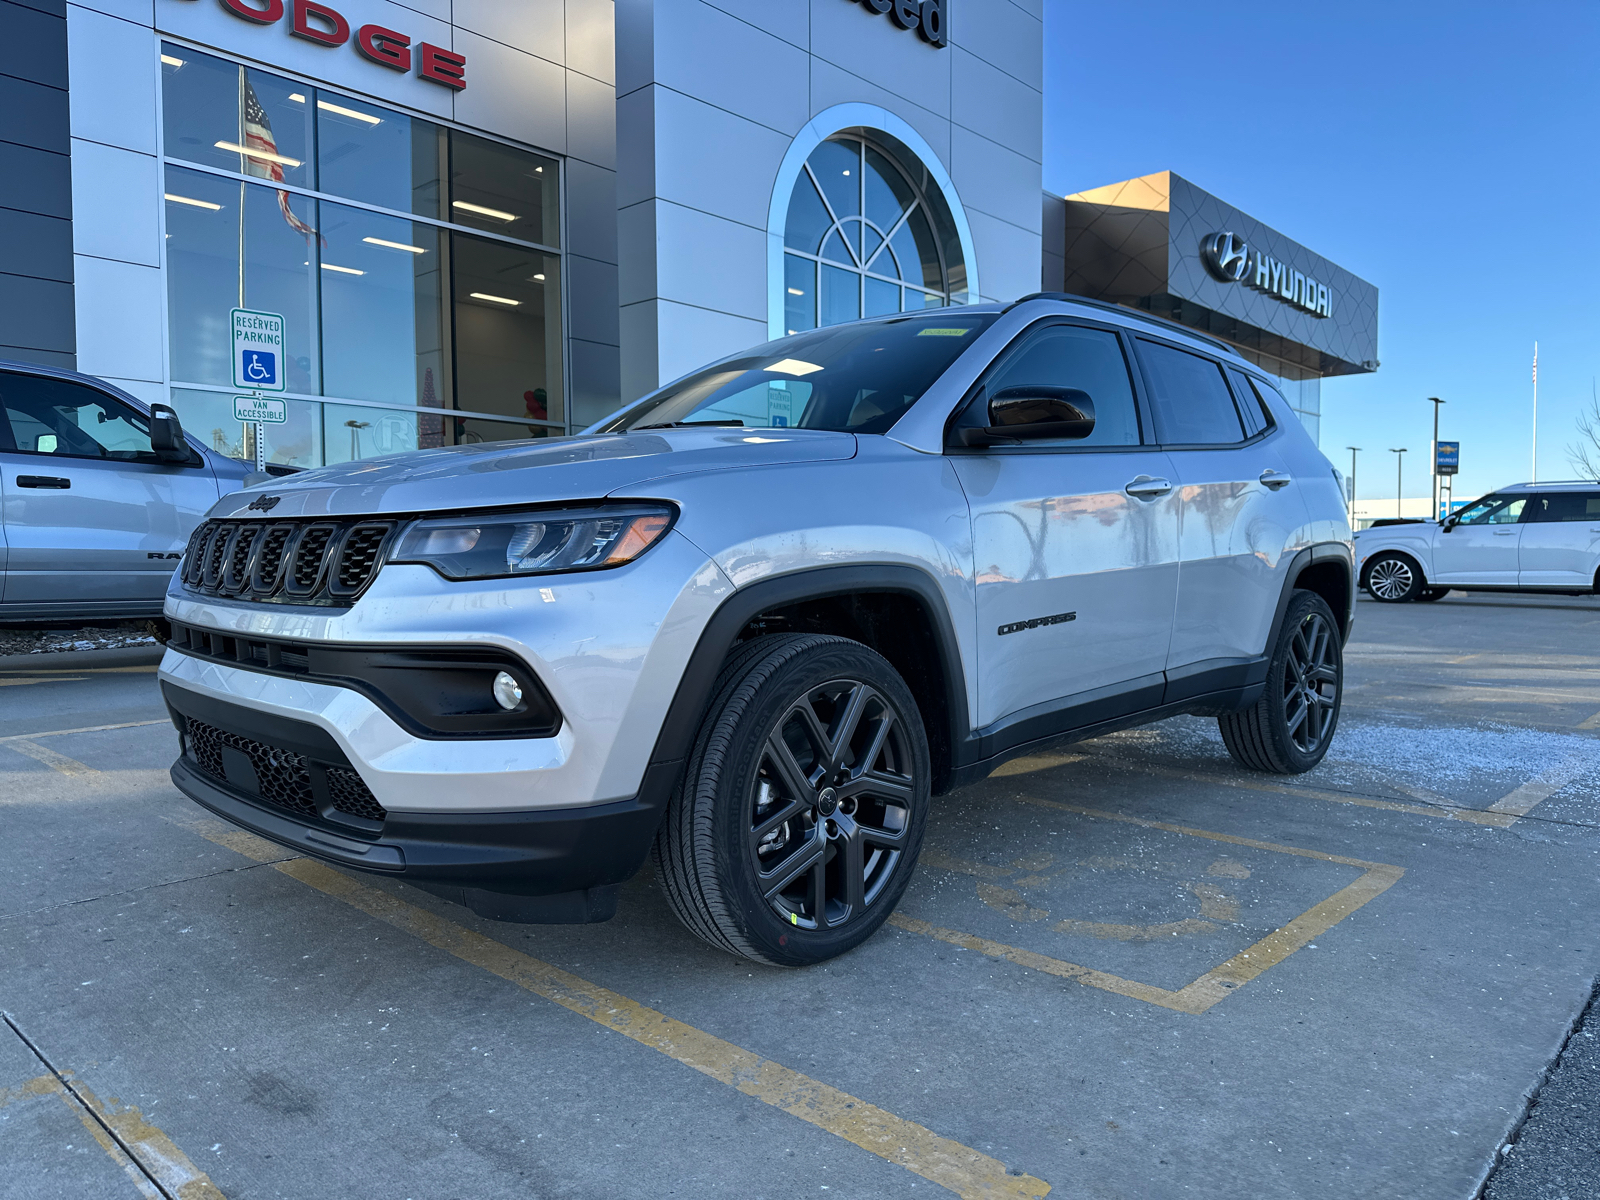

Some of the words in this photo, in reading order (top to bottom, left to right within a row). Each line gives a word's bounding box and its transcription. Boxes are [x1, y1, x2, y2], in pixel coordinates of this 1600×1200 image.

[848, 0, 947, 49] ed
[190, 0, 466, 92] DGE
[1255, 251, 1333, 319] HYUNDAI
[236, 316, 279, 332] RESERVED
[236, 330, 280, 345] PARKING
[252, 401, 268, 409] VAN
[237, 409, 283, 420] ACCESSIBLE
[248, 493, 281, 513] Jeep
[147, 552, 185, 560] RA
[997, 611, 1077, 636] COMPASS
